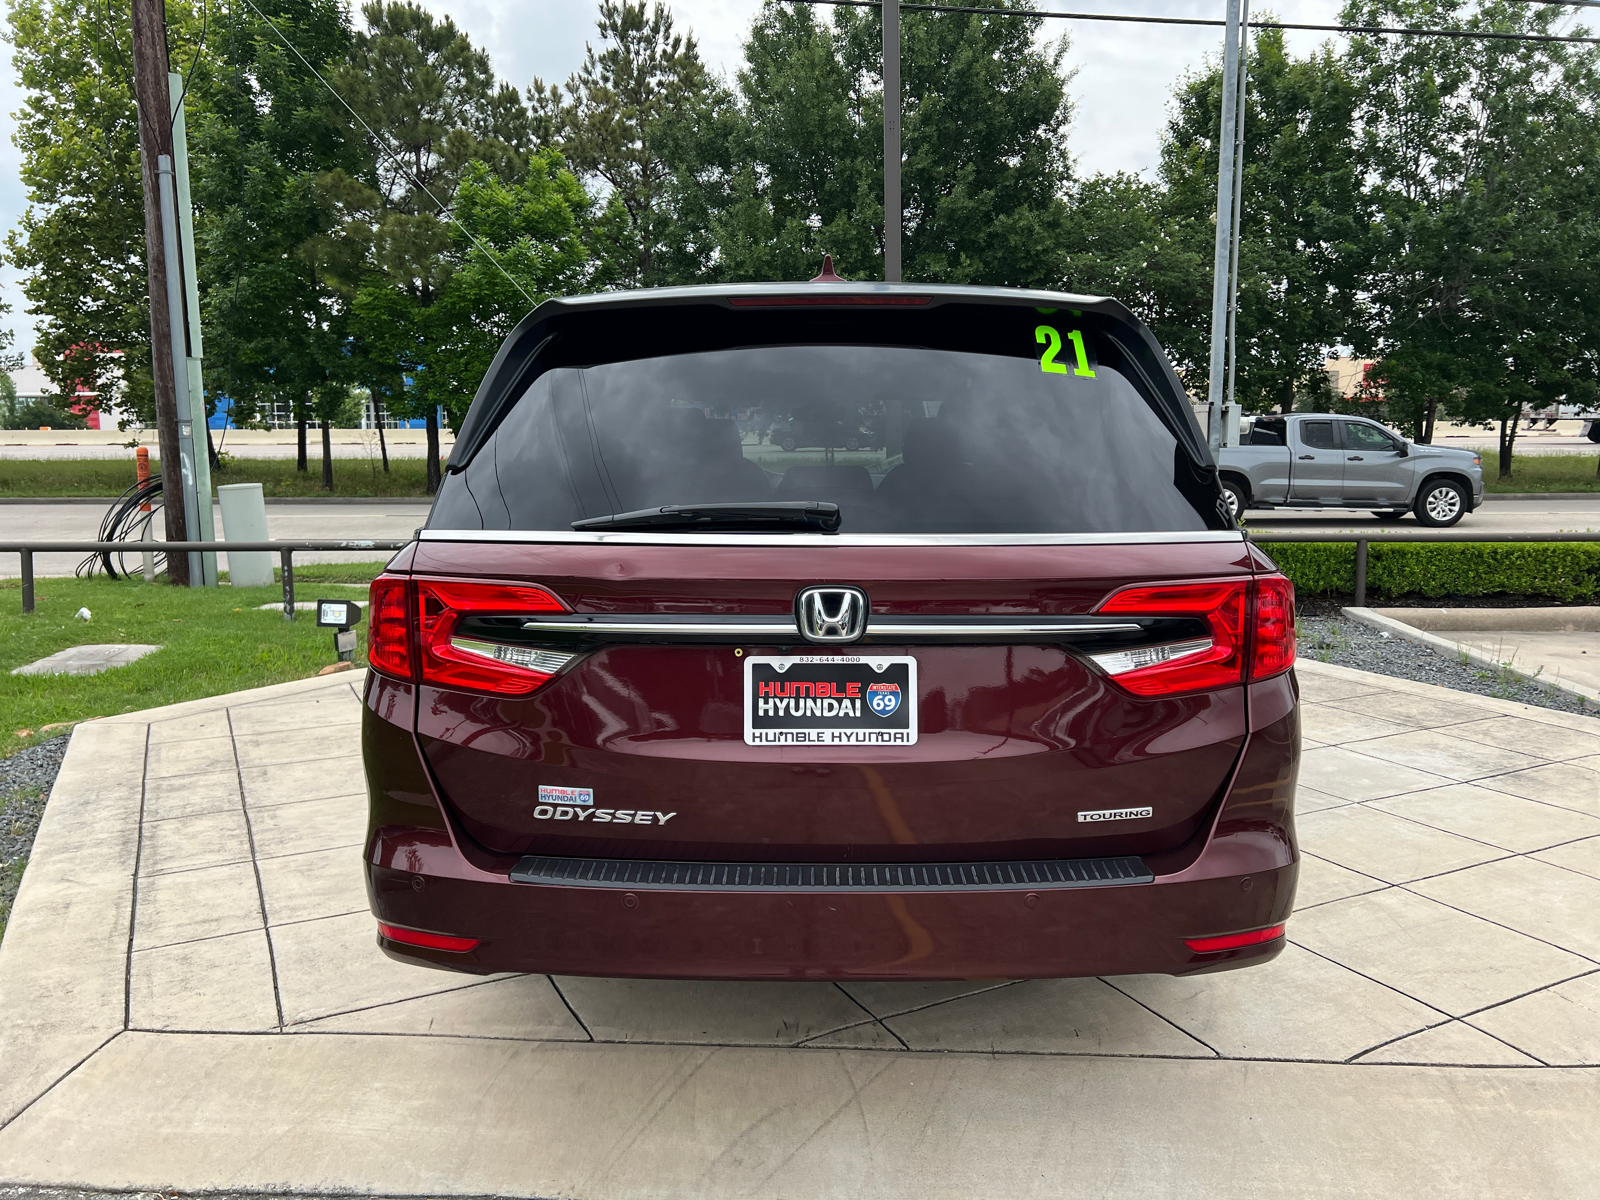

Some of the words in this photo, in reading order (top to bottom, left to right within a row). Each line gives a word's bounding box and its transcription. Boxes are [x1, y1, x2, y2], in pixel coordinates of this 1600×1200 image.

[1035, 325, 1096, 378] 21
[759, 681, 861, 697] HUMBLE
[758, 698, 861, 717] HYUNDAI
[872, 695, 896, 711] 69
[752, 732, 825, 742] HUMBLE
[831, 732, 910, 742] HYUNDAI
[540, 788, 577, 796] HUMBLE
[540, 793, 577, 803] HYUNDAI
[533, 805, 677, 825] ODYSSEY
[1080, 810, 1151, 821] TOURING
